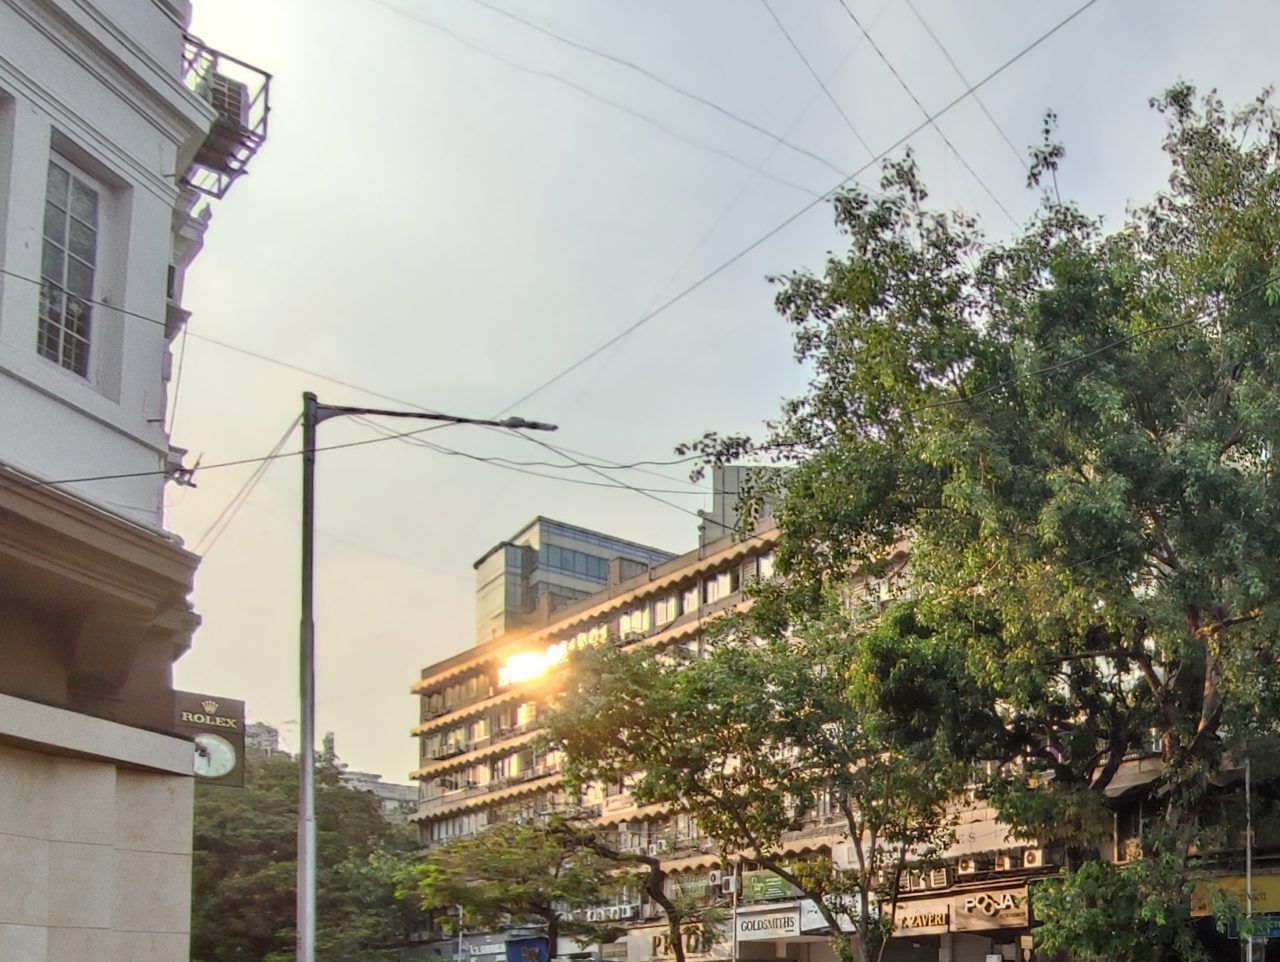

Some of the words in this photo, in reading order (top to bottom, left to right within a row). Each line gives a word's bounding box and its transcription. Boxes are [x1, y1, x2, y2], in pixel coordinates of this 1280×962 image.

[182, 711, 237, 728] ROLEX
[964, 893, 1014, 916] POOJA
[741, 916, 795, 932] GOLDSMITHS
[911, 913, 947, 928] ZAVERI
